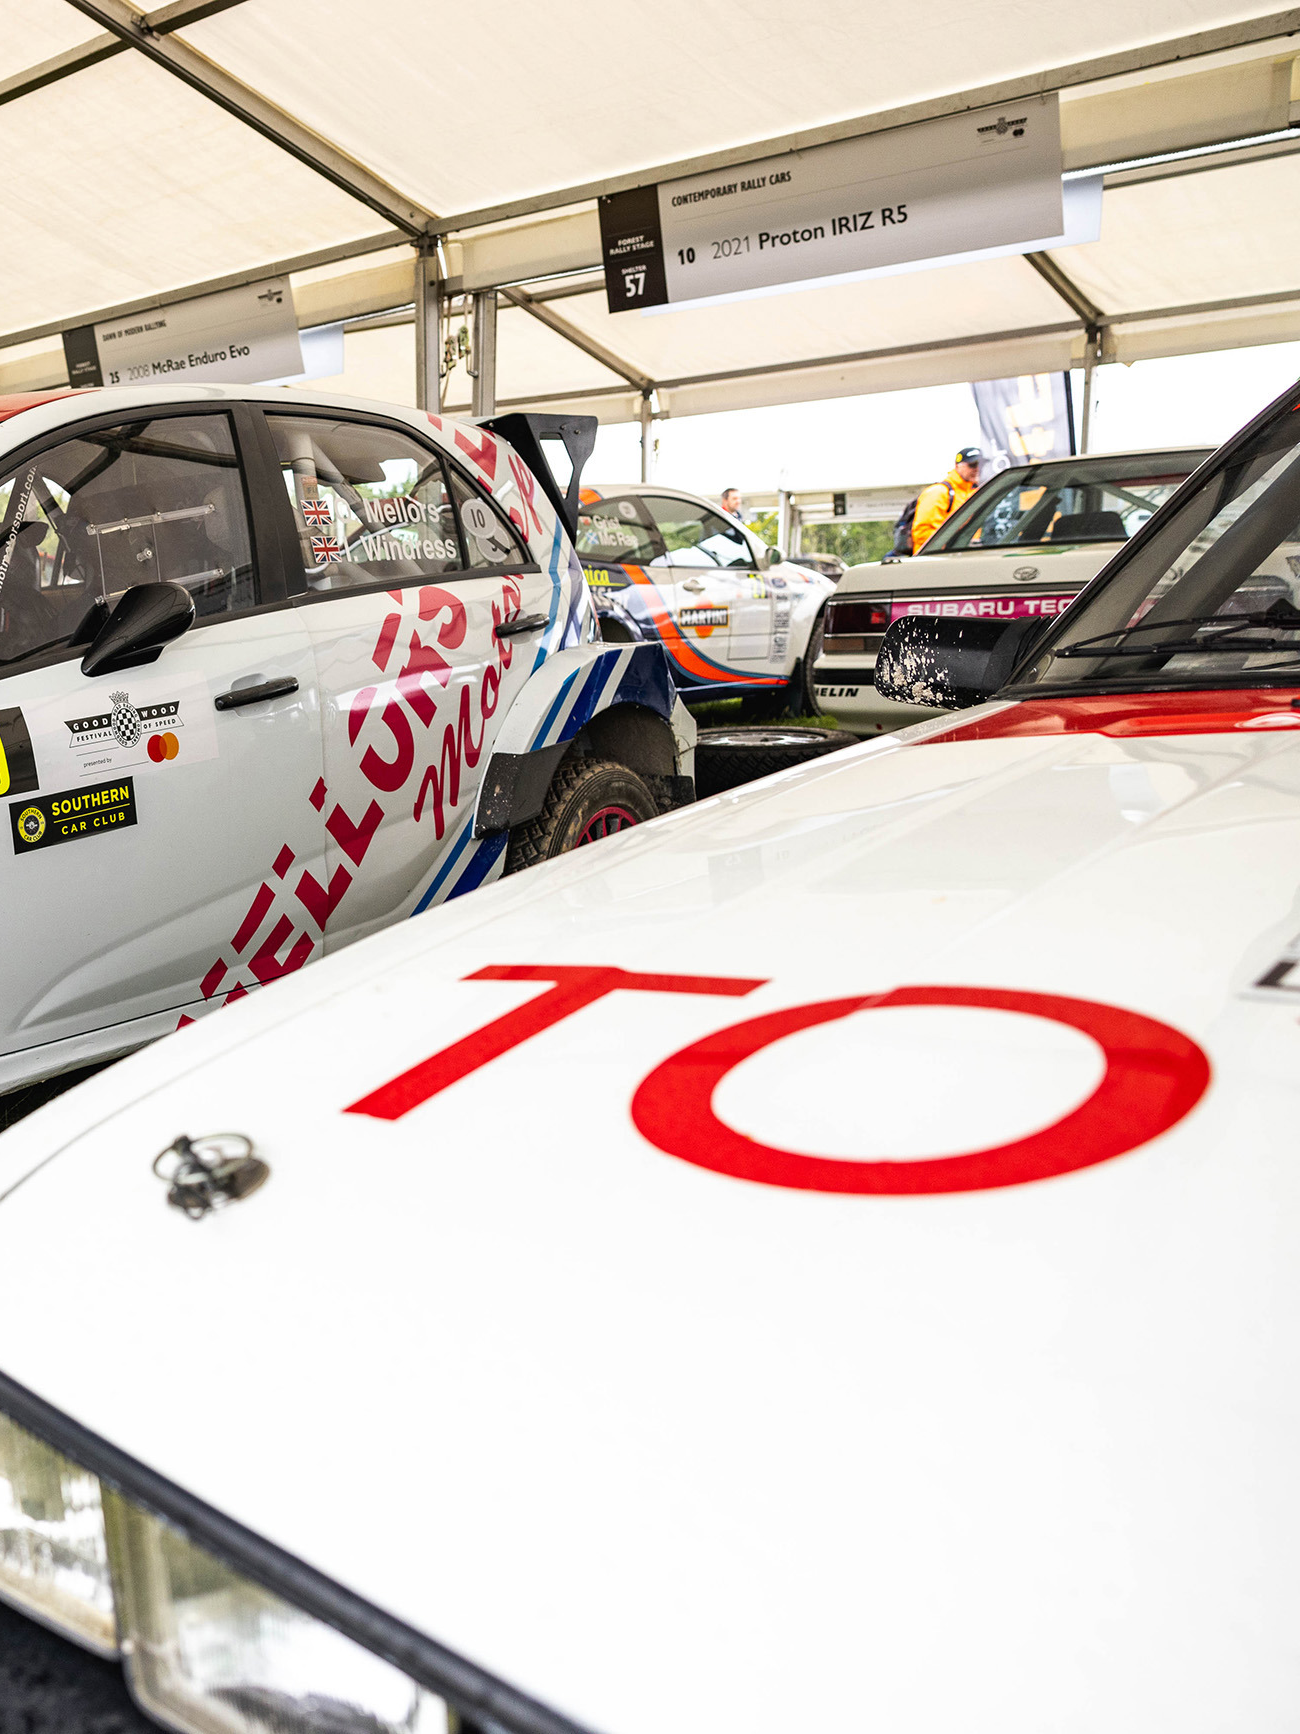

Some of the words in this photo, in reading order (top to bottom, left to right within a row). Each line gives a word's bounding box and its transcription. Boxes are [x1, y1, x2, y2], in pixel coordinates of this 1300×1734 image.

[671, 183, 738, 207] CONTEMPORARY
[741, 176, 766, 192] RALLY
[769, 171, 792, 186] CARS
[677, 247, 696, 266] 10
[711, 235, 751, 260] 2021
[758, 222, 825, 250] Proton
[831, 210, 875, 236] IRIZ
[880, 204, 908, 227] R5
[624, 272, 646, 298] 57
[109, 371, 120, 384] 25
[127, 364, 150, 381] 2008
[152, 356, 186, 375] McRae
[188, 349, 227, 368] Enduro
[229, 344, 251, 359] Evo
[362, 497, 440, 524] Mellors
[470, 508, 486, 529] 10
[360, 535, 457, 562] Windress
[681, 609, 727, 626] MARTINI
[906, 600, 1015, 616] SUBARU
[73, 717, 109, 731] GOOD
[140, 705, 176, 718] WOOD
[76, 731, 112, 742] FESTIVAL
[155, 718, 177, 728] SPEED
[83, 758, 106, 768] presented
[51, 785, 130, 816] SOUTHERN
[20, 809, 42, 821] SOUTHERN
[61, 821, 87, 835] CAR
[93, 812, 126, 827] CLUB
[32, 830, 43, 841] CLUB
